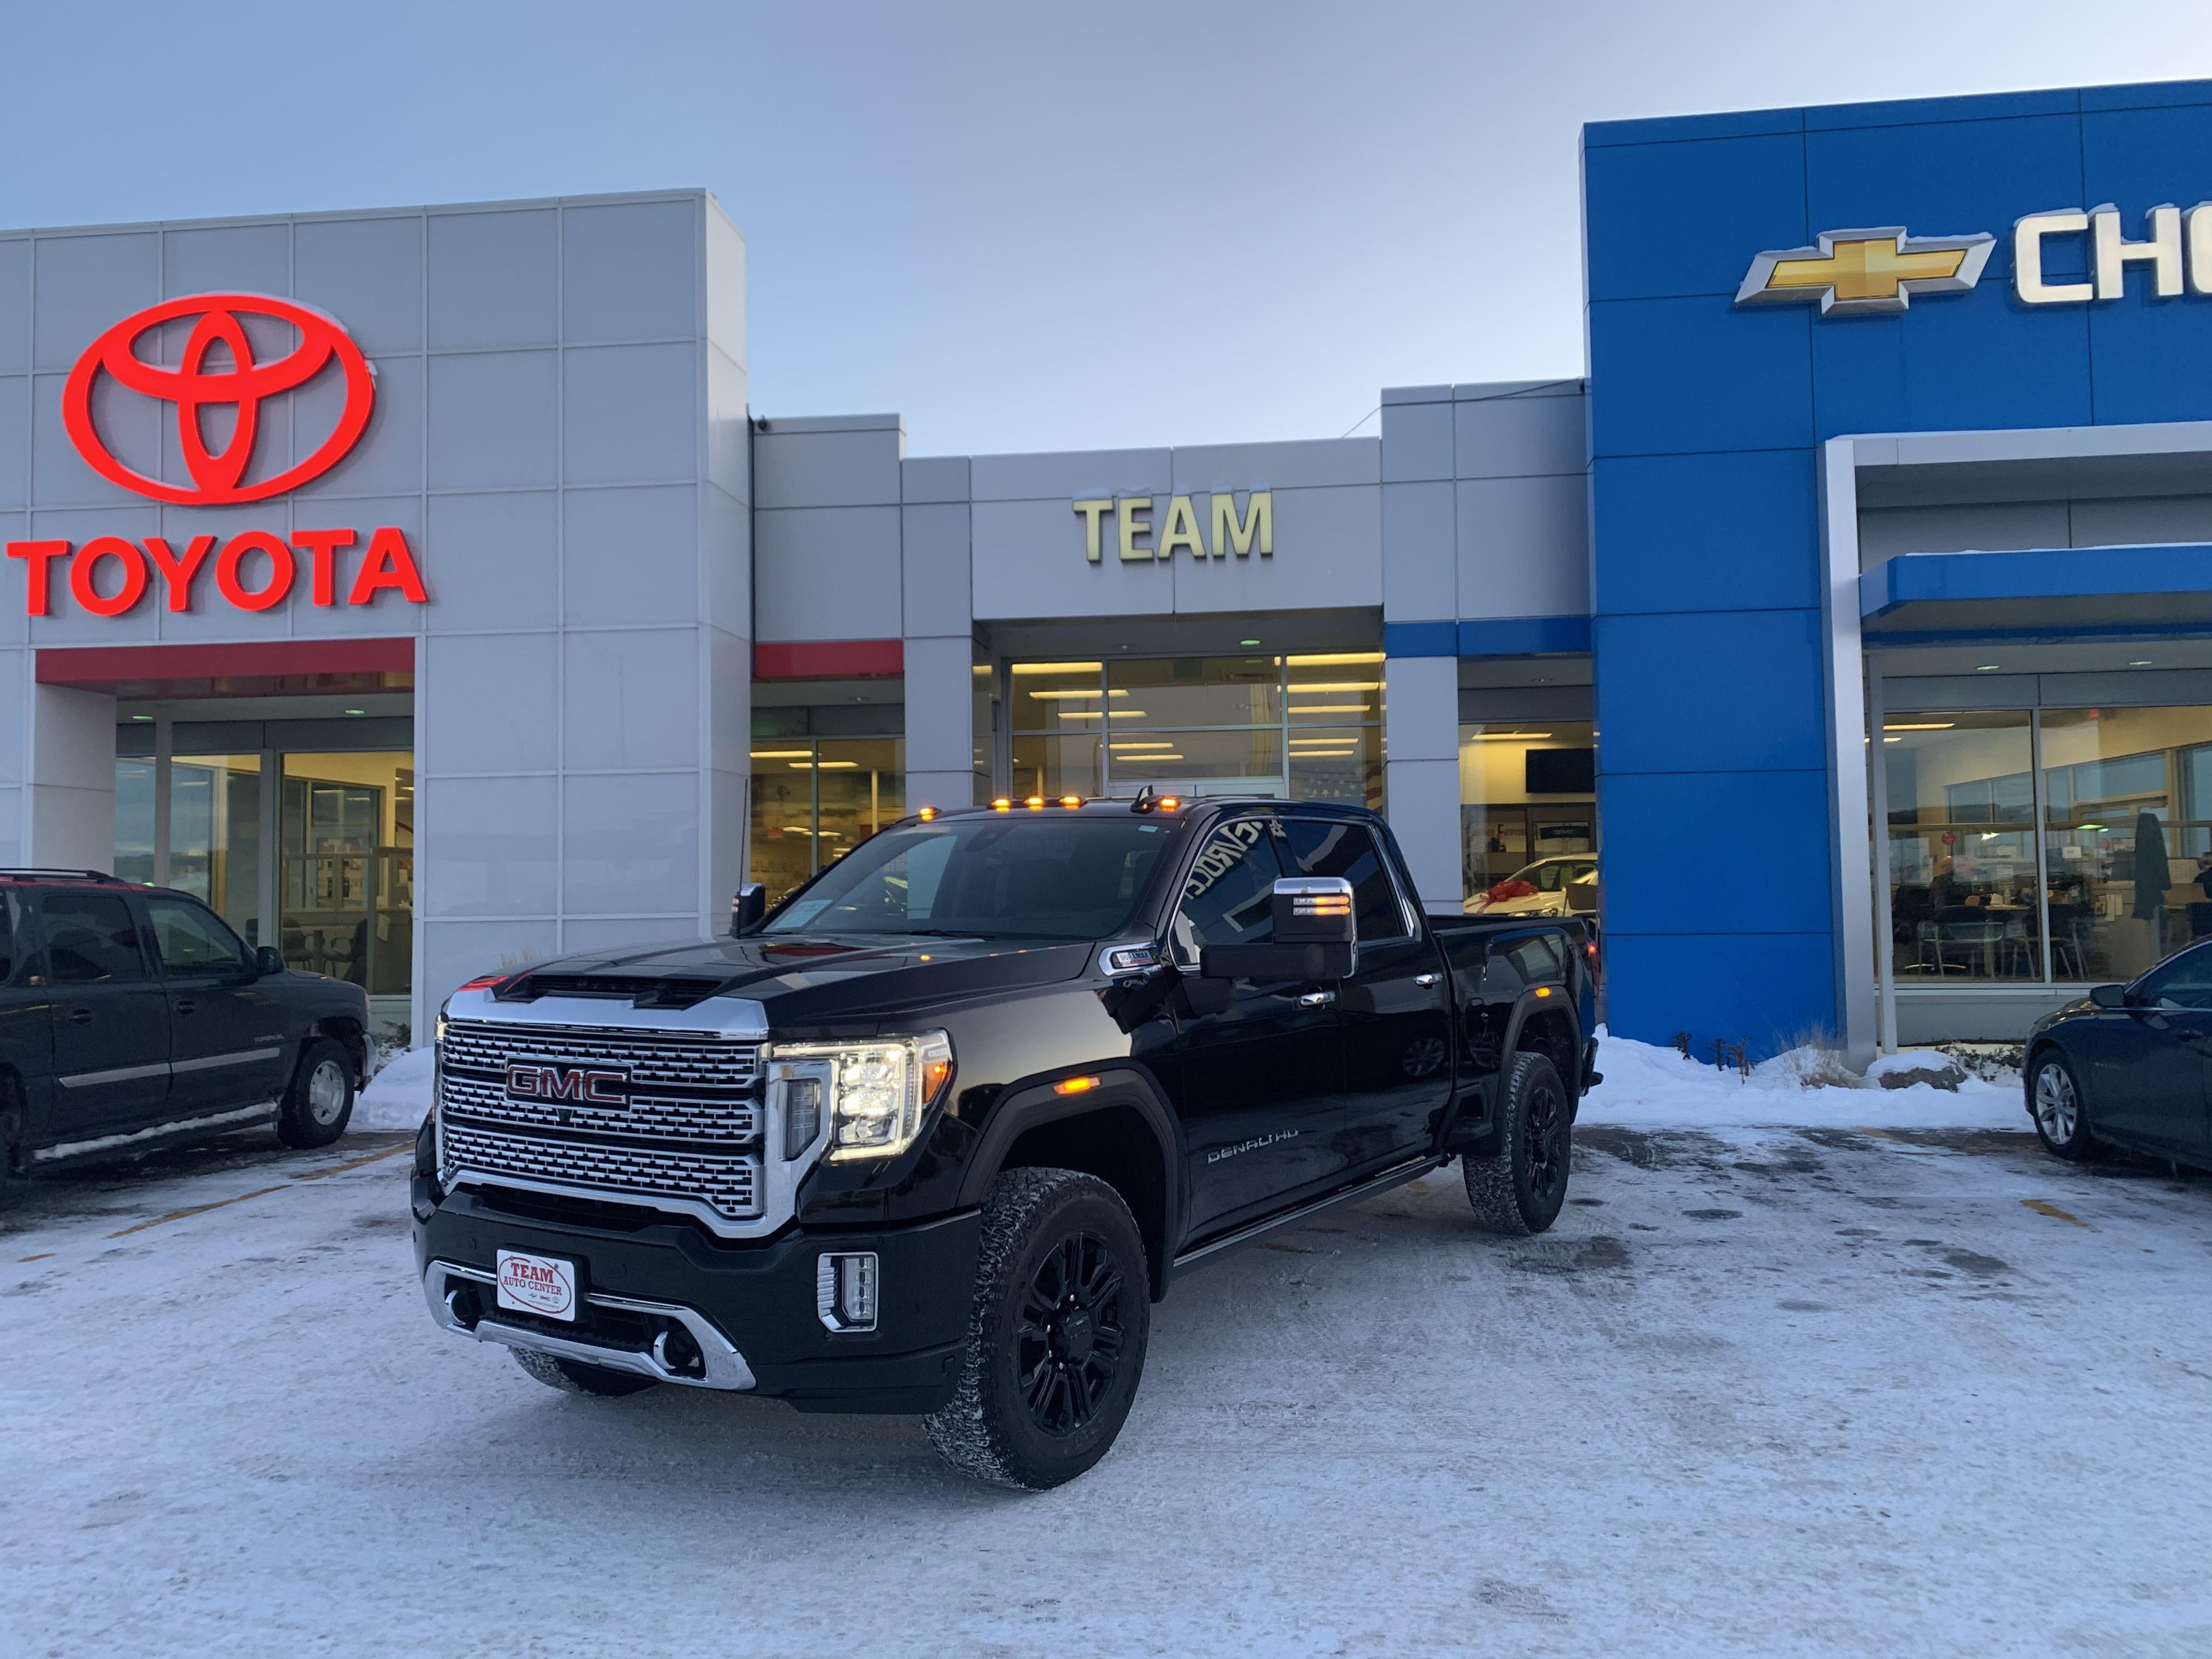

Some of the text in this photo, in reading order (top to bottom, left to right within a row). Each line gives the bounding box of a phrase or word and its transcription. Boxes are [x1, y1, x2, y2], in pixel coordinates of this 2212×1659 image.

[2016, 205, 2212, 303] CH
[1072, 491, 1272, 562] TEAM
[6, 527, 428, 617] TOYOTA
[1120, 952, 1149, 961] DURAMAX
[507, 1064, 628, 1104] GMC
[1208, 1128, 1299, 1164] DENALI HD
[504, 1276, 562, 1296] AUTO CENTER
[511, 1262, 554, 1284] TEAM
